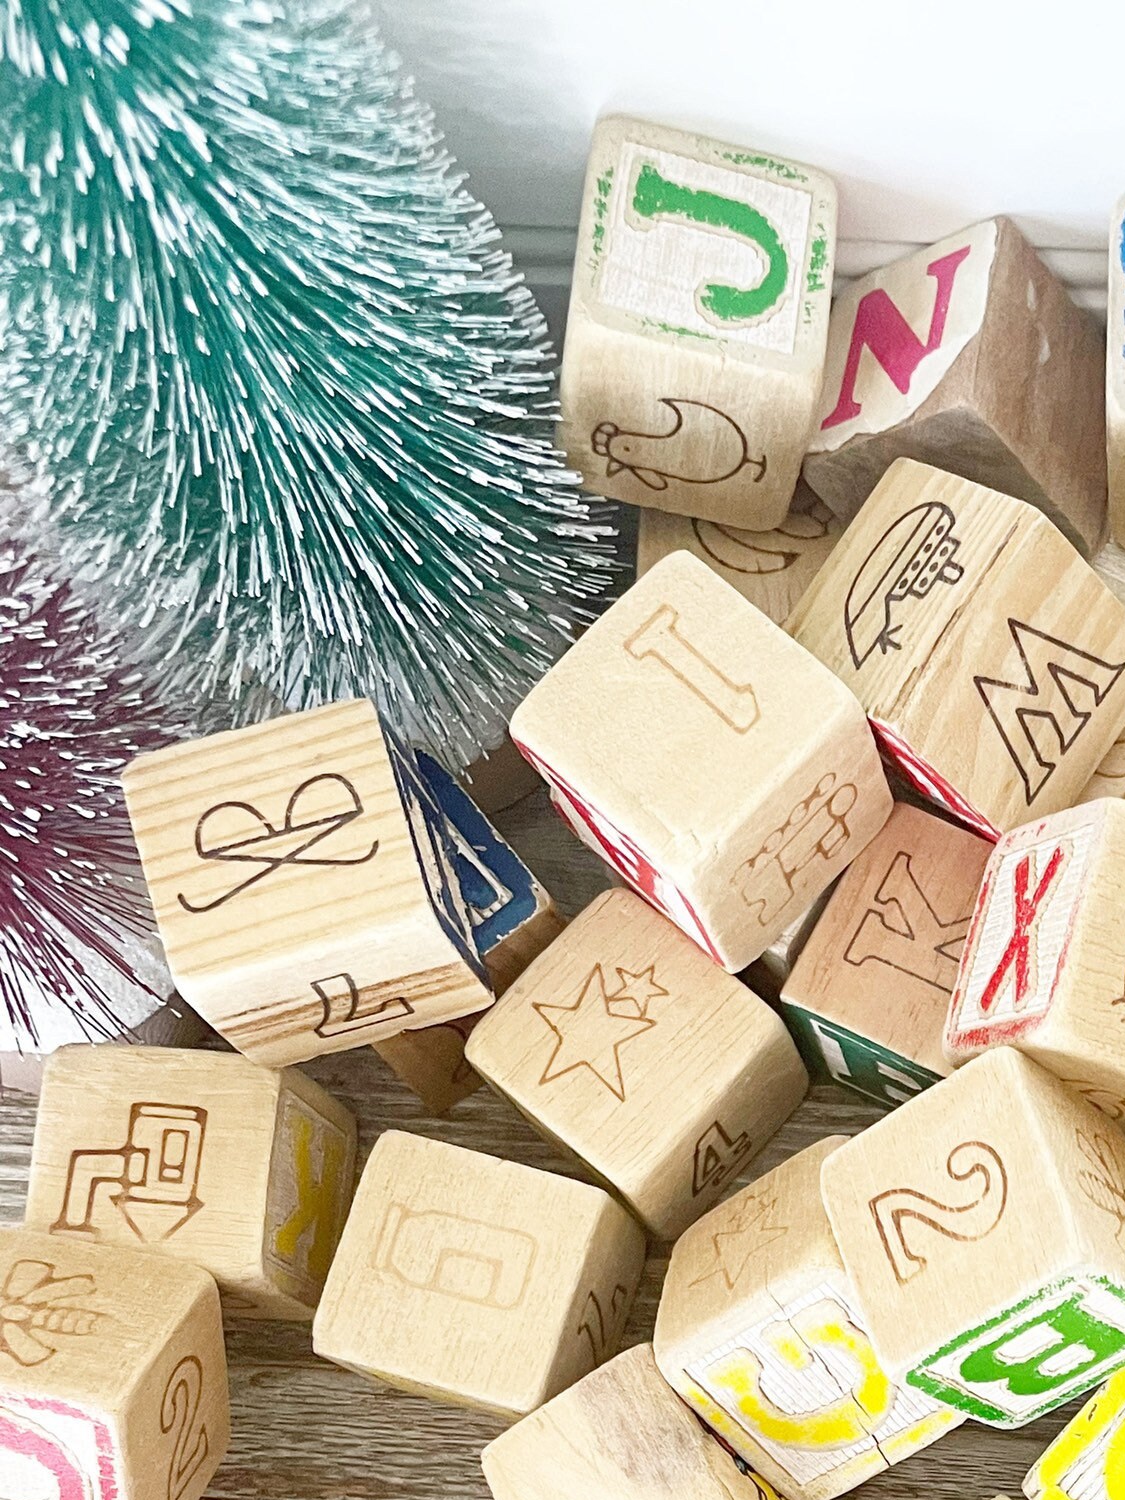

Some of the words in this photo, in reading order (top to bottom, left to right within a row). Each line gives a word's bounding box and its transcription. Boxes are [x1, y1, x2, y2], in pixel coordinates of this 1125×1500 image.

[633, 163, 790, 321] J
[820, 244, 972, 431] N
[979, 845, 1068, 1014] X
[690, 1121, 753, 1199] 4
[867, 1139, 1009, 1287] 2
